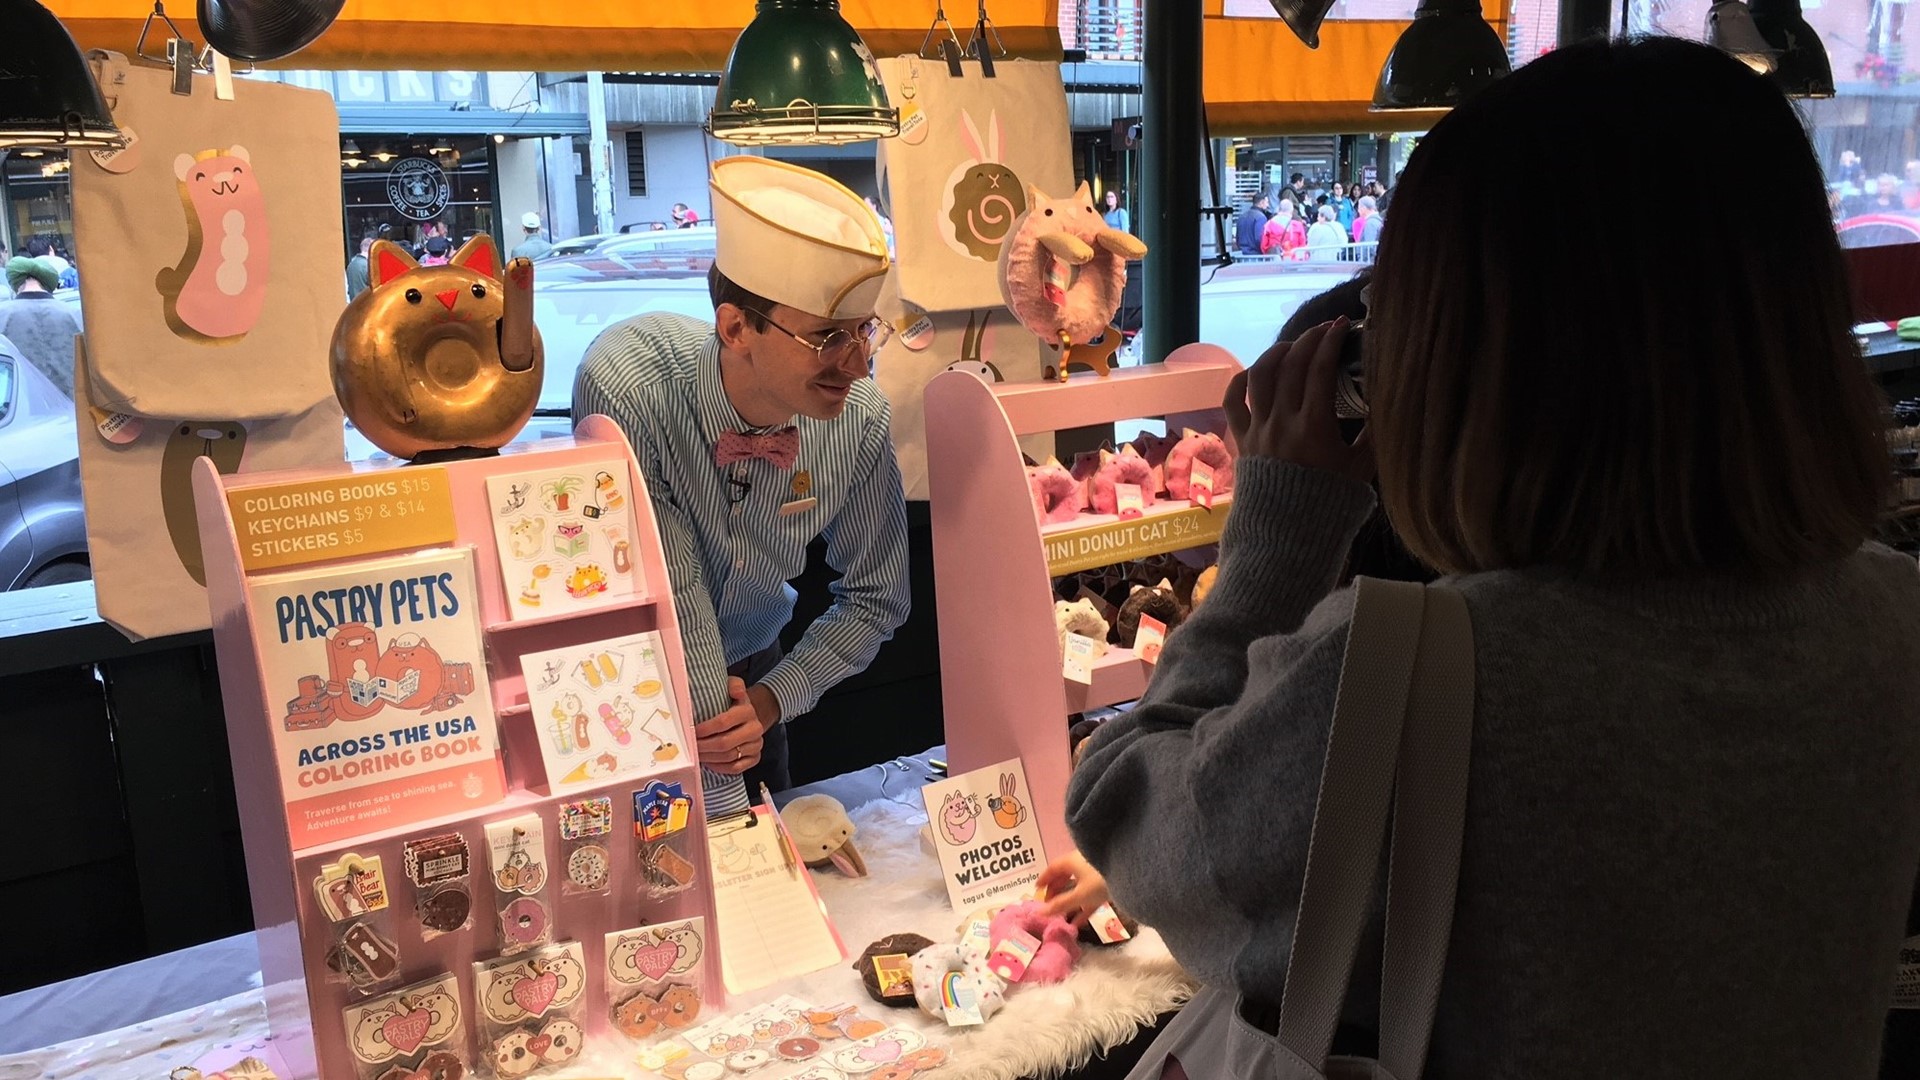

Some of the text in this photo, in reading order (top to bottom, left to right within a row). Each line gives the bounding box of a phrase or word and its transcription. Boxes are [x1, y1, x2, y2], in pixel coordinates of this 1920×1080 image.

[396, 160, 437, 174] STARBUCKS
[389, 184, 447, 218] COFFEE TEA SPICES
[244, 477, 430, 514] COLORING BOOKS $15
[248, 499, 425, 535] KEYCHAINS $9 & $14
[251, 528, 364, 557] STICKERS $5
[1079, 528, 1135, 555] DONUT
[1140, 521, 1169, 542] CAT
[1173, 515, 1199, 537] $24
[276, 572, 459, 643] PASTRY PETS
[298, 716, 477, 767] ACROSS THE USA
[298, 735, 482, 788] COLORING BOOK
[305, 781, 456, 820] Traverse from sea to shining sea.
[306, 805, 391, 831] Adventure awaits!
[493, 829, 541, 845] KEYAIN
[425, 856, 460, 869] SPRINKLE
[960, 835, 1022, 867] PHOTOS
[755, 867, 776, 878] SIGN
[955, 848, 1036, 886] WELCOME!
[360, 880, 379, 893] Bear
[963, 895, 976, 905] tag
[976, 892, 985, 901] us
[637, 951, 677, 967] PASTRY
[645, 960, 668, 973] PALS
[515, 982, 556, 1001] PASTRY
[525, 994, 549, 1008] PALS
[384, 1018, 429, 1041] PASTRY
[395, 1028, 421, 1045] PALS
[530, 1040, 548, 1050] LOVE
